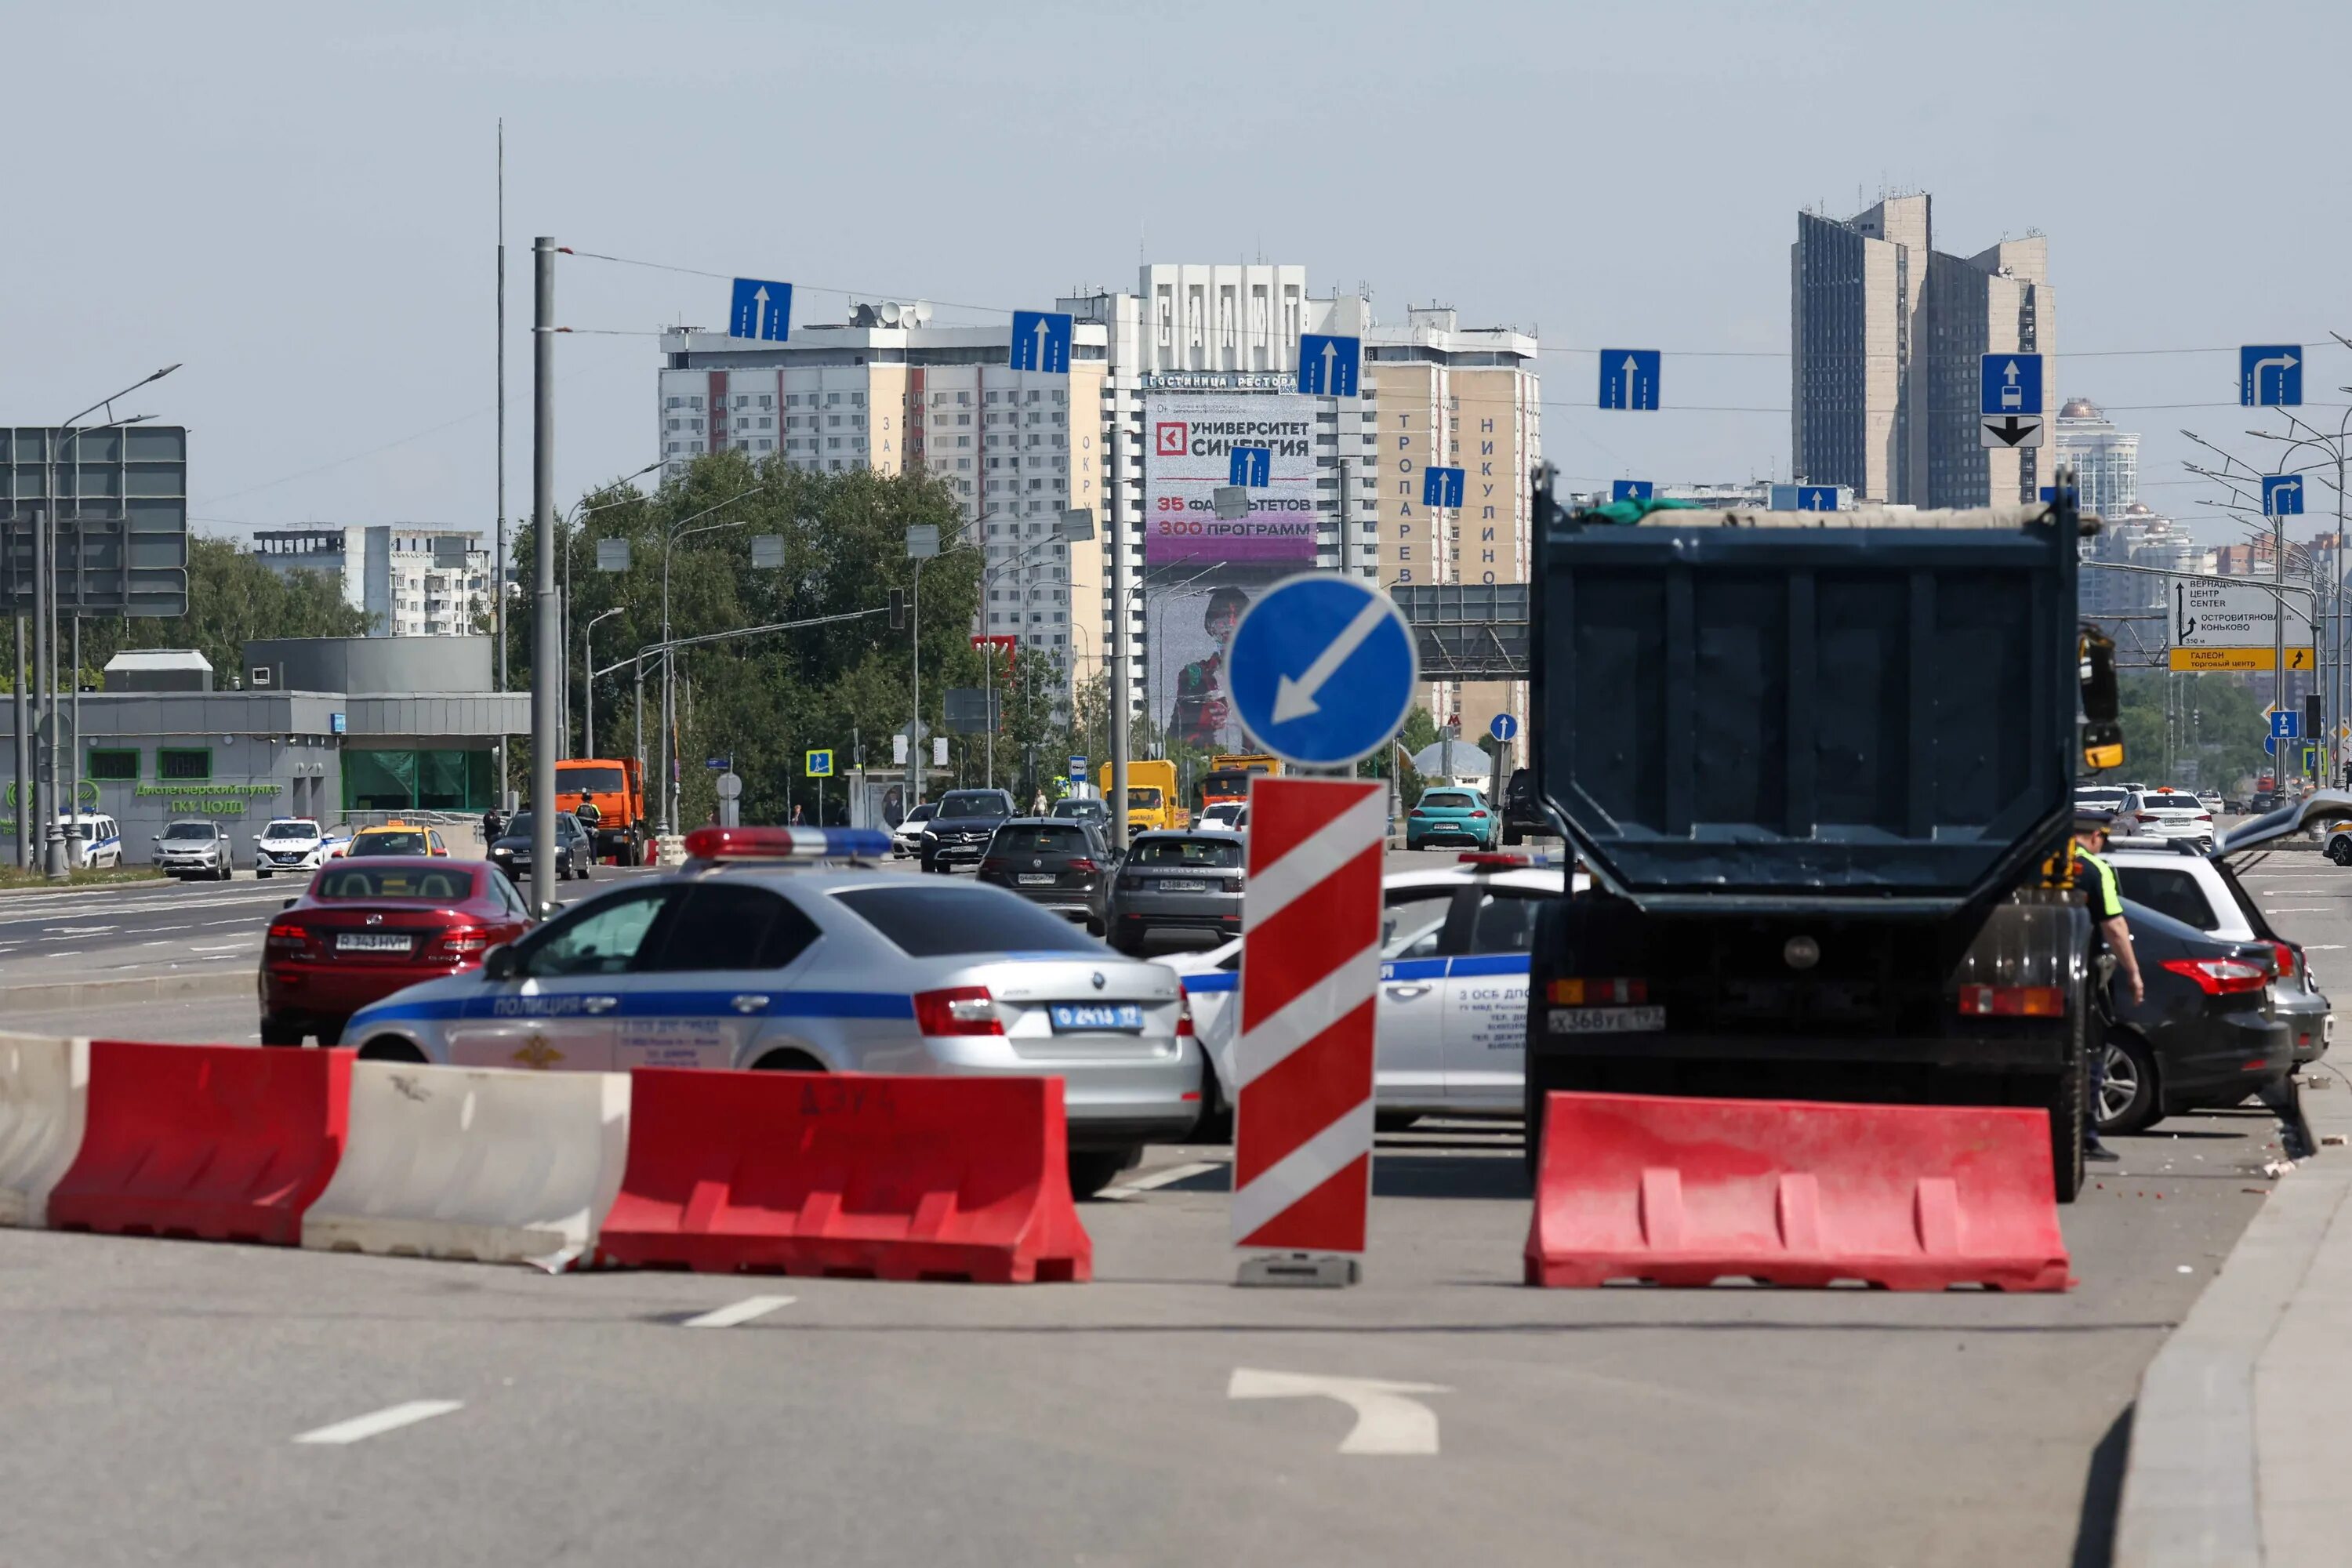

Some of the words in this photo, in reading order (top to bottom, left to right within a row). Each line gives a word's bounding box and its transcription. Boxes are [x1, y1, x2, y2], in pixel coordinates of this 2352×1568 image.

[1157, 296, 1298, 347] САЛЮТ
[1149, 376, 1227, 387] ГОСТИНИЦА
[1237, 376, 1298, 387] РЕСТОРА
[1156, 404, 1168, 413] 0+
[1191, 422, 1309, 435] УНИВЕРСИТЕТ
[1157, 496, 1185, 511] 35
[1189, 499, 1311, 511] ФАЬТЕТОВ
[1399, 414, 1411, 583] ТРОПАРЕВ
[1481, 419, 1495, 585] НИКУЛИНО
[1158, 521, 1203, 535] 300
[1207, 524, 1310, 535] ПРОГРАММ
[1447, 714, 1461, 725] М
[135, 782, 238, 797] Диспетчерский
[171, 800, 197, 812] ГКУ
[1472, 989, 1500, 1000] ОСБ
